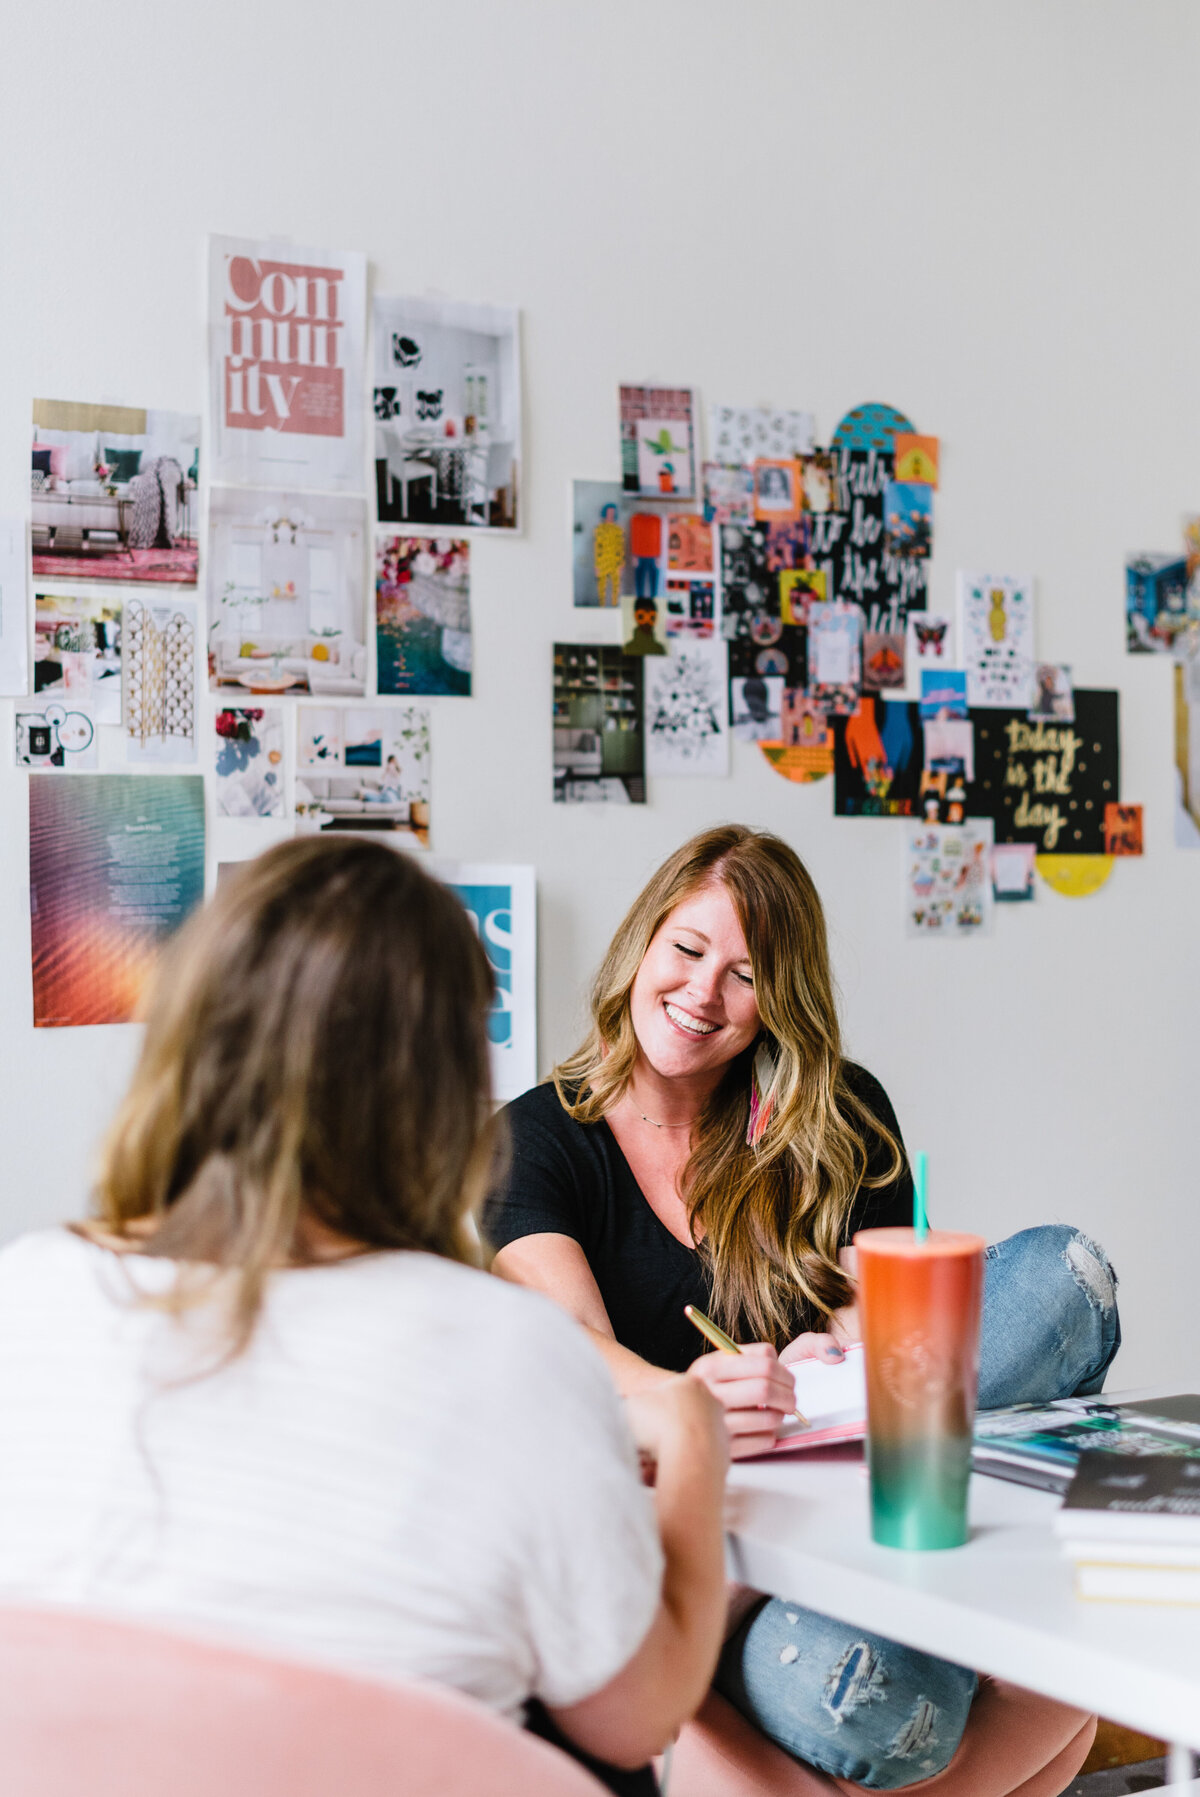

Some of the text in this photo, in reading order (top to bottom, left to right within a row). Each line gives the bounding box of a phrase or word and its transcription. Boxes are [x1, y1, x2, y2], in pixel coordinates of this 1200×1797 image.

[228, 354, 303, 434] ity
[1004, 718, 1083, 775] today
[1004, 754, 1071, 794] is the
[1014, 791, 1068, 849] day
